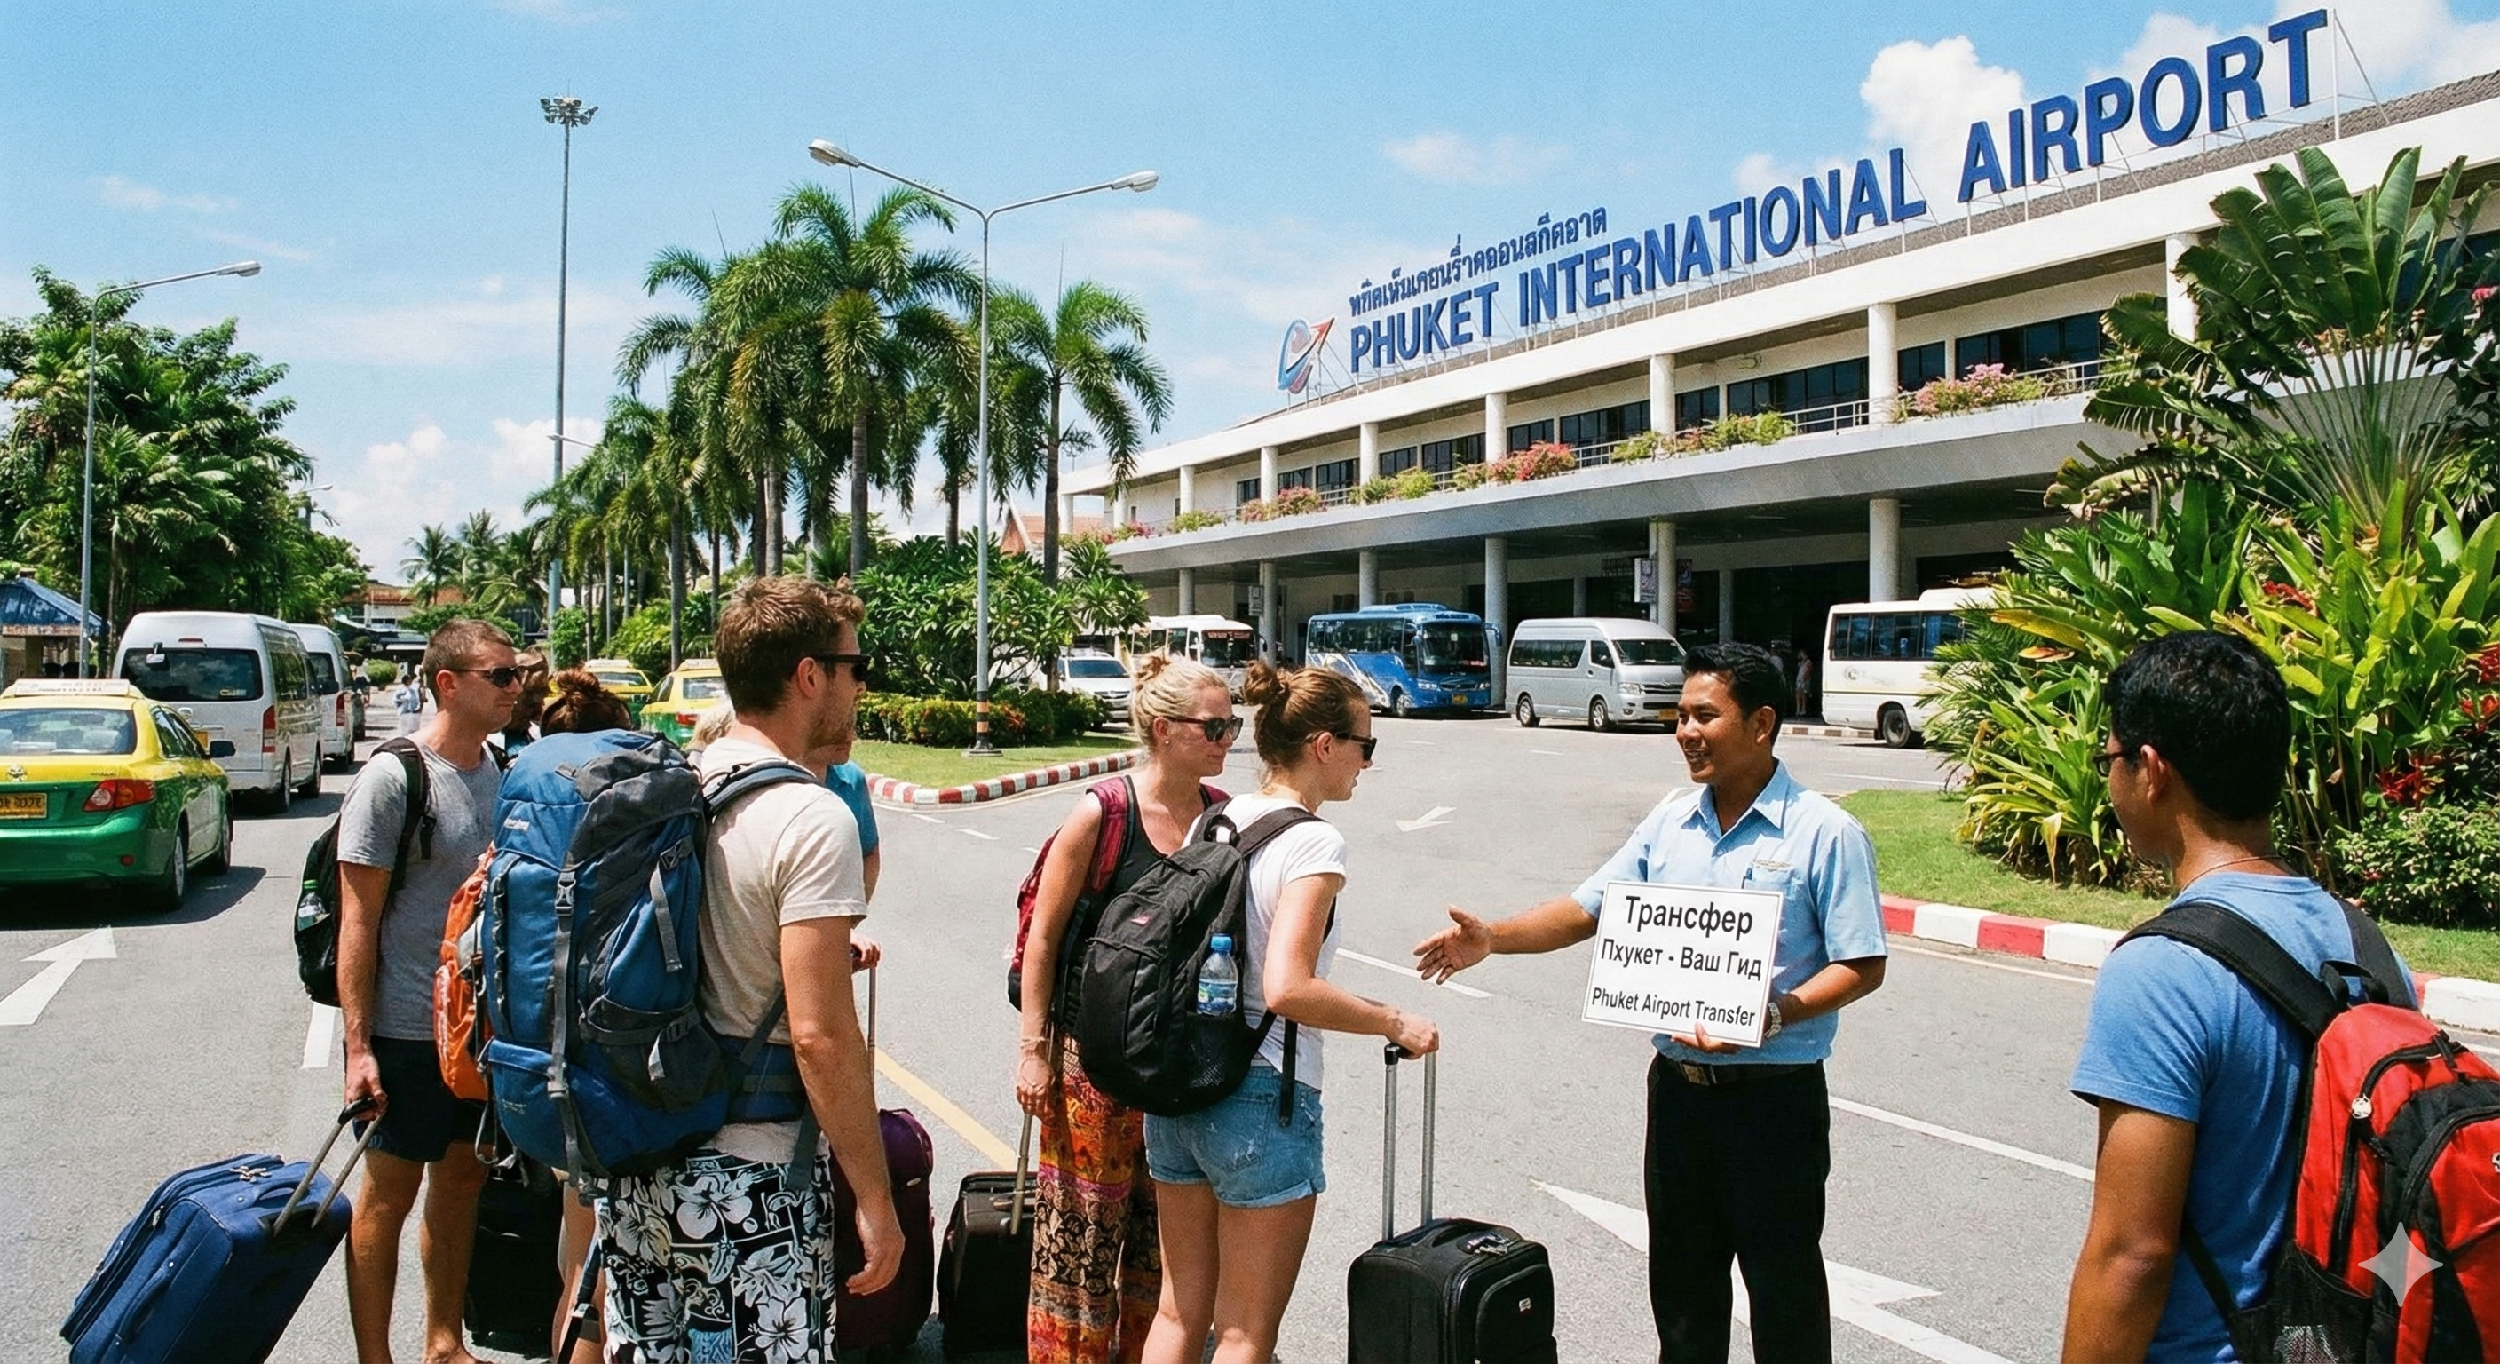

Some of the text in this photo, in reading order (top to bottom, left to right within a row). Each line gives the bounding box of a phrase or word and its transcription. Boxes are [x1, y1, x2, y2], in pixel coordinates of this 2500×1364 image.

[1350, 8, 2328, 374] PHUKET INTERNATIONAL AIRPORT
[1625, 895, 1753, 941] Трансфер
[1601, 938, 1664, 968] Пхукет
[1680, 946, 1721, 972] Ваш
[1726, 951, 1762, 981] Гид
[1592, 986, 1756, 1027] Phuket Airport Transfer
